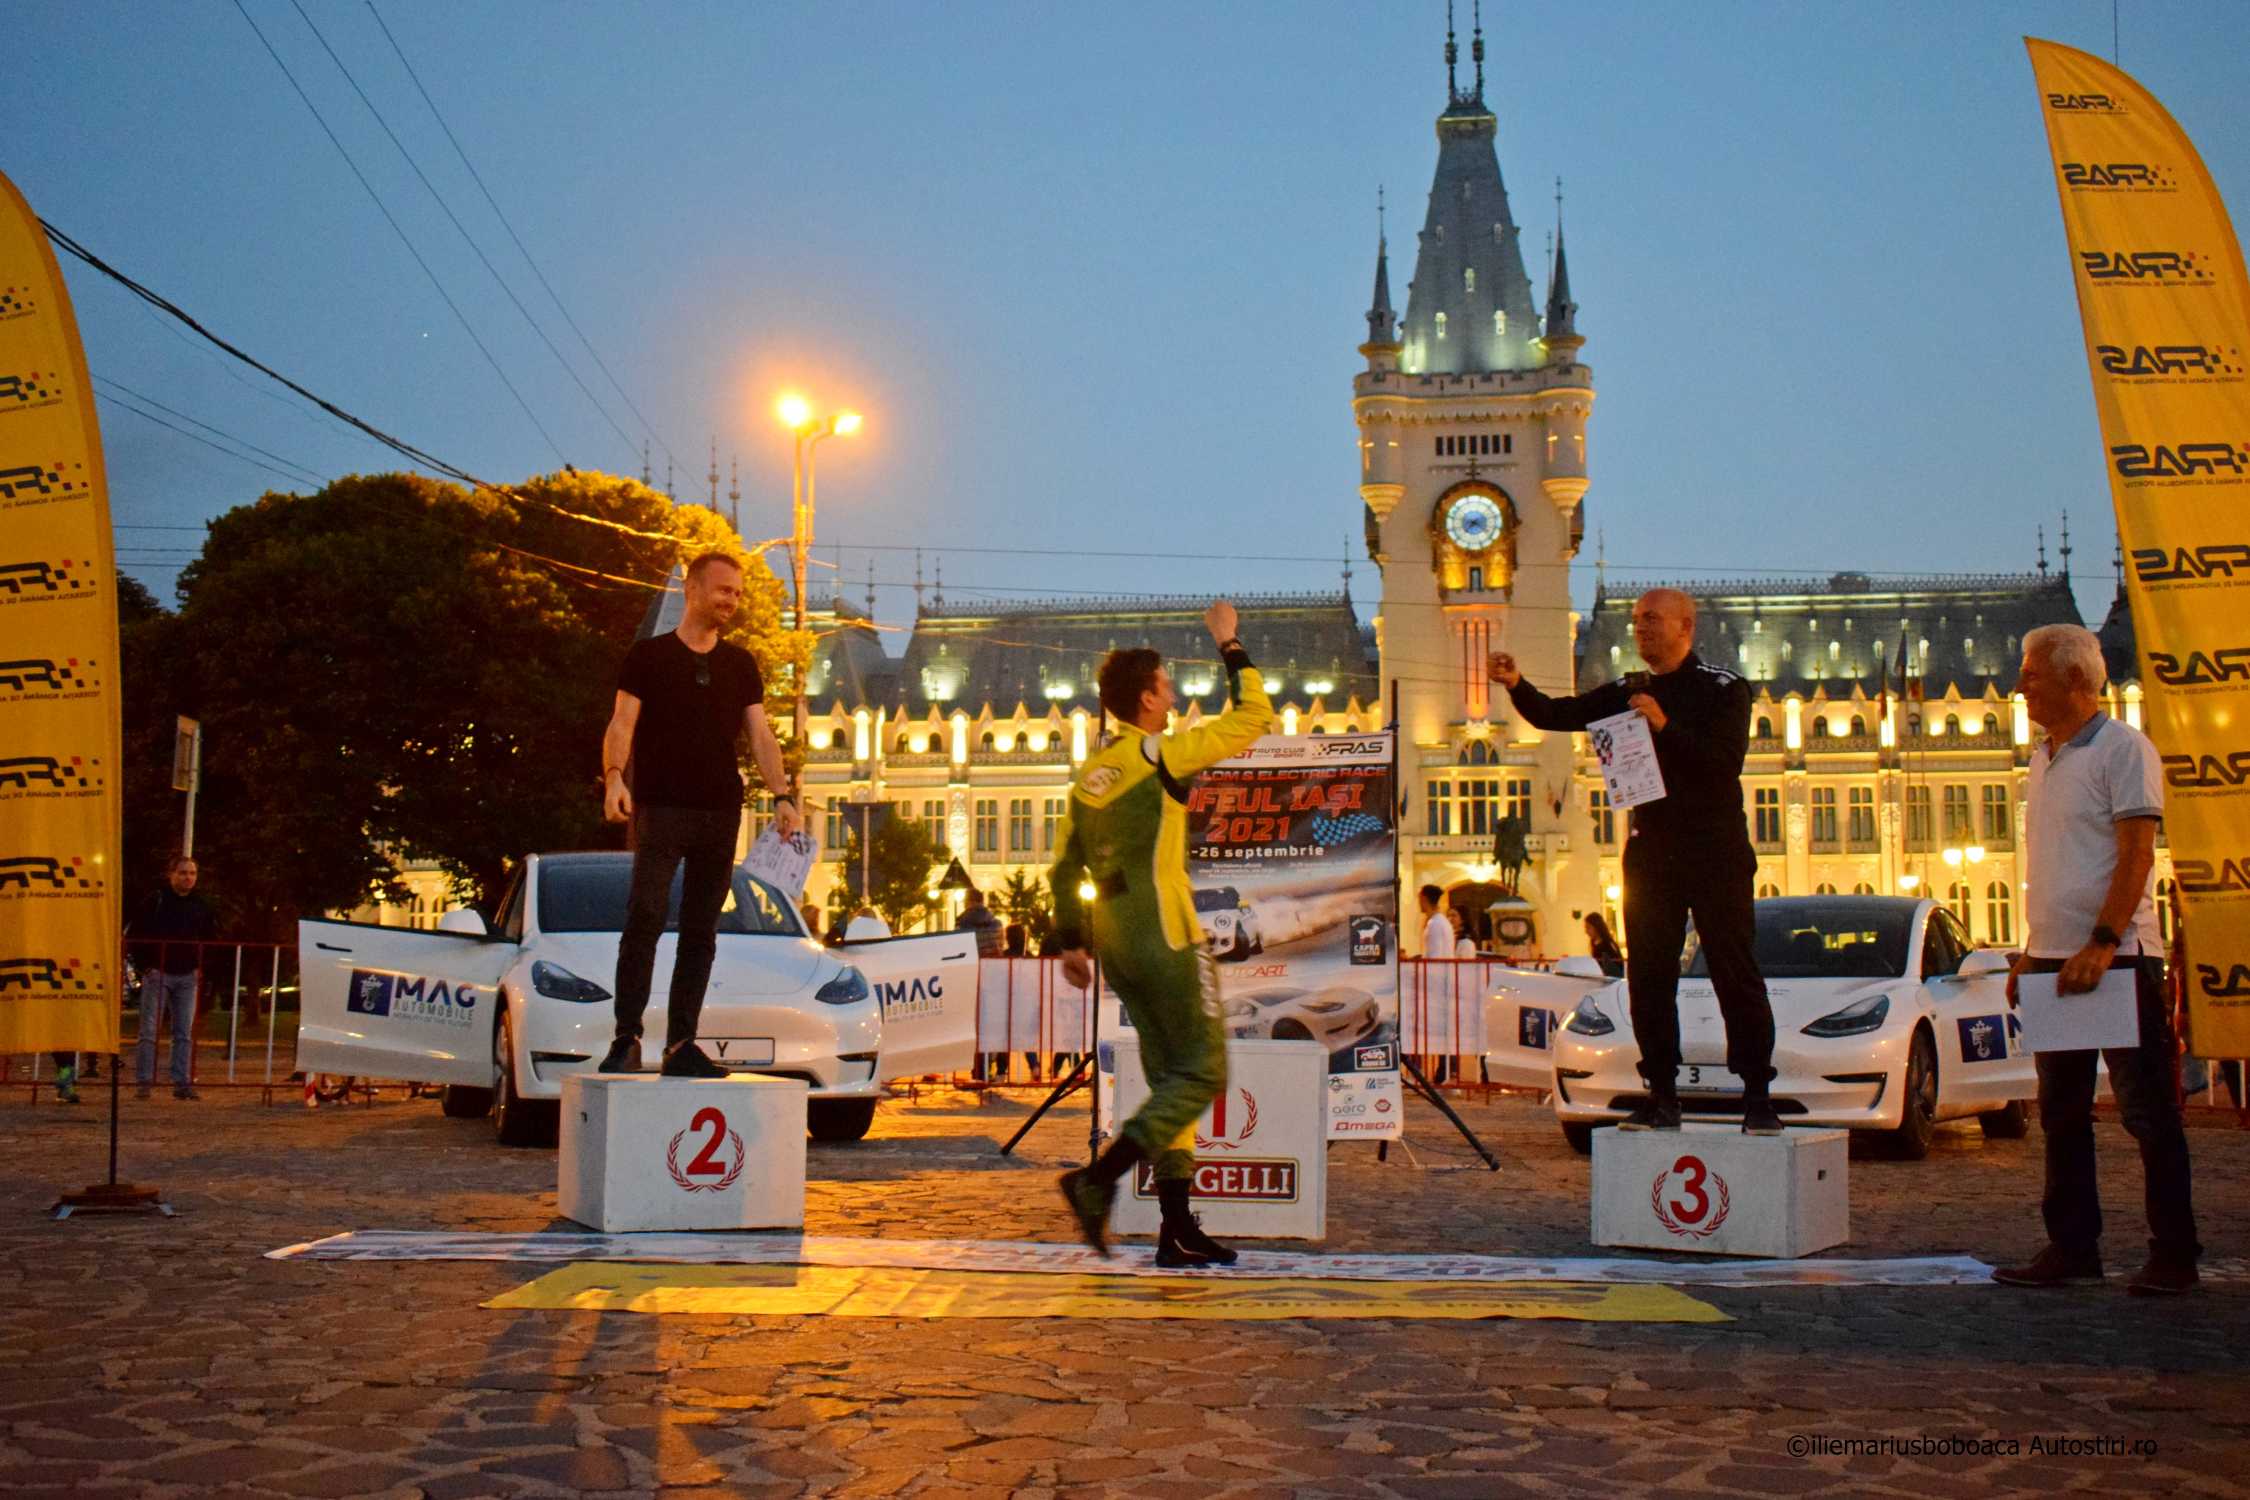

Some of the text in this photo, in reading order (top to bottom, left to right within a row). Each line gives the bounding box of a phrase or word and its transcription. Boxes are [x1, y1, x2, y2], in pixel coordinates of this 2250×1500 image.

[1325, 741, 1383, 755] FRAS
[1257, 768, 1337, 781] ELECTRIC
[1340, 766, 1387, 778] RACE
[1205, 815, 1290, 843] 2021
[1224, 844, 1324, 860] septembrie
[395, 976, 476, 1008] MAG
[885, 975, 943, 1006] MAG
[1689, 1067, 1700, 1084] 3
[686, 1106, 727, 1175] 2
[1670, 1155, 1710, 1225] 3
